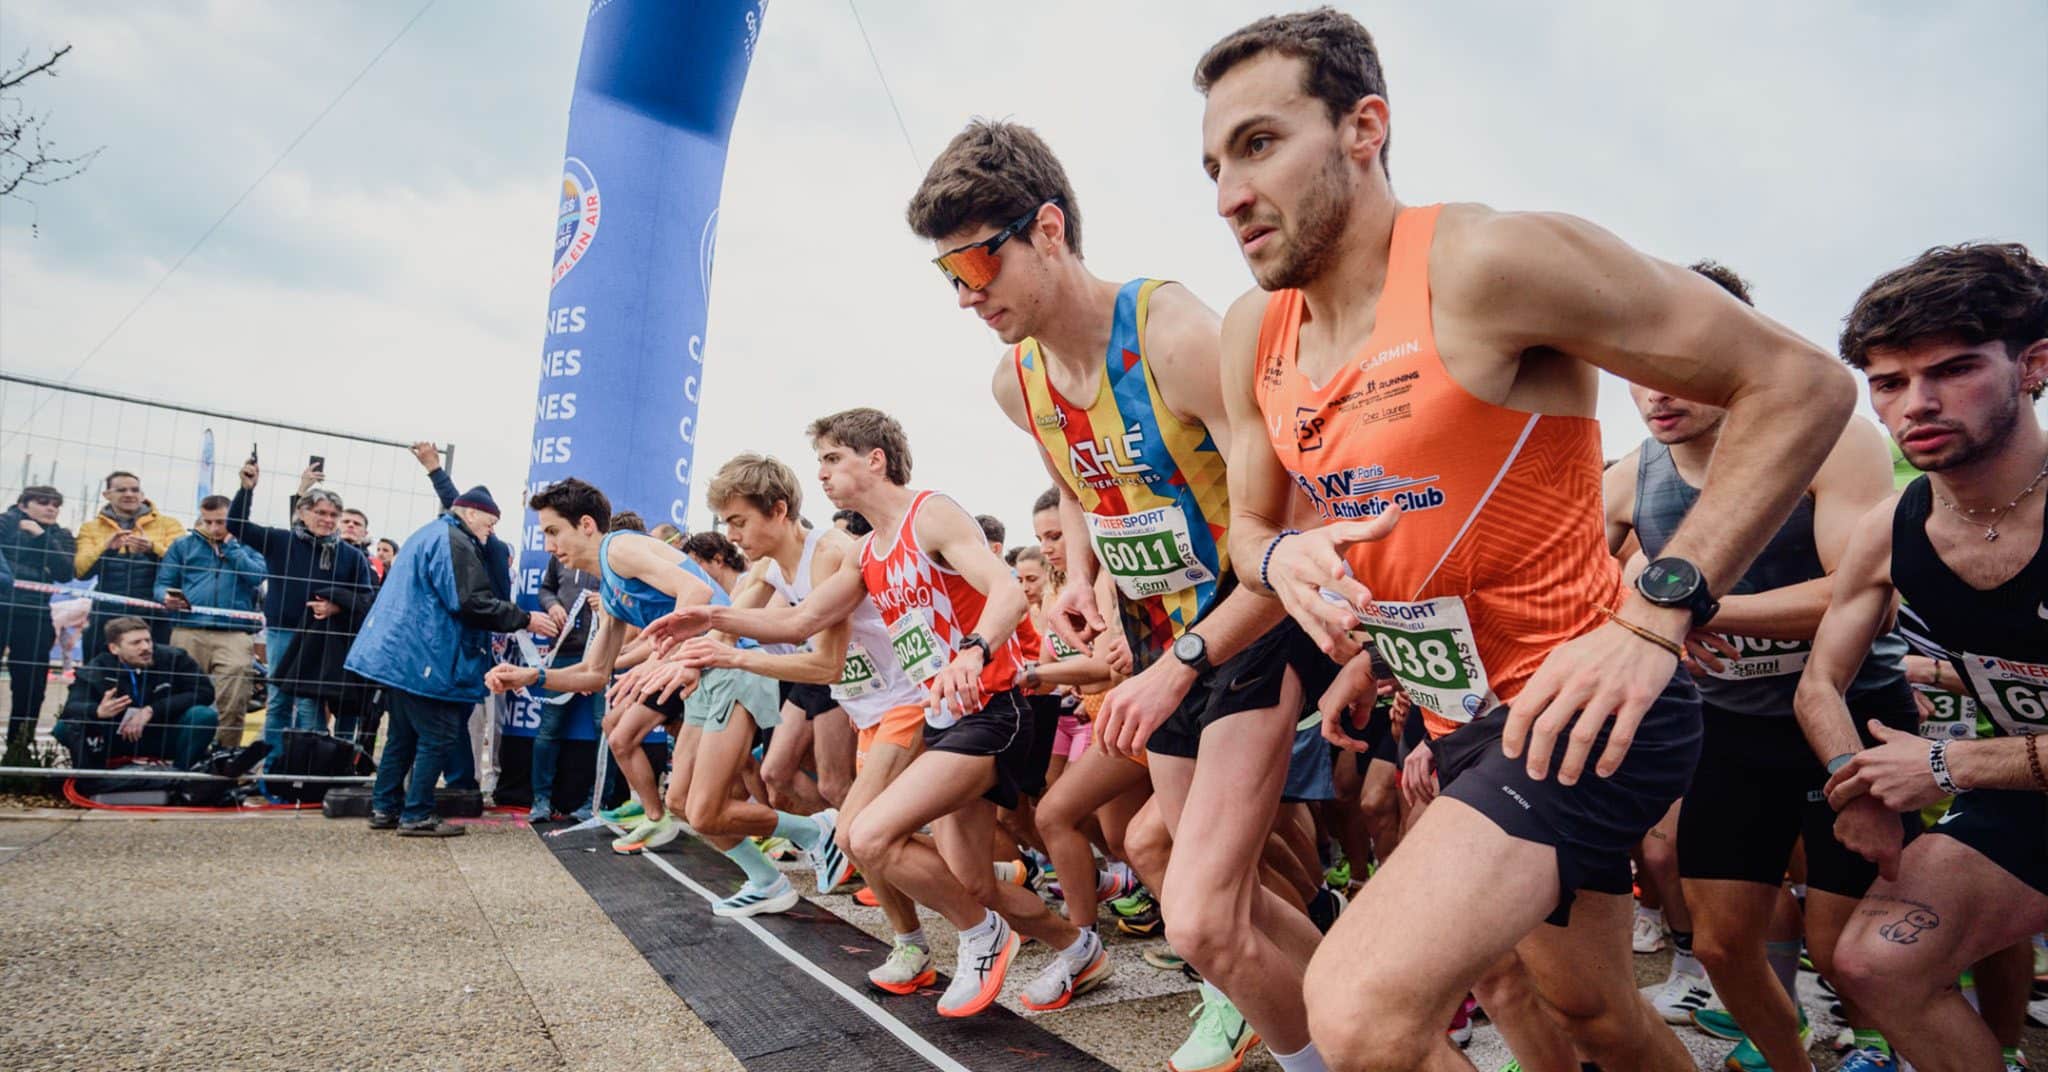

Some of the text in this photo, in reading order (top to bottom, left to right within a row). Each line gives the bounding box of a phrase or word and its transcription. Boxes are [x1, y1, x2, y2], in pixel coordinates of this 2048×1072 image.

[586, 194, 598, 226] AIR
[1360, 340, 1419, 372] GARMIN
[1382, 402, 1411, 417] Laurent
[1357, 464, 1384, 479] Paris
[1332, 487, 1444, 518] Athletic Club
[1103, 538, 1178, 572] 6011
[1178, 543, 1198, 567] SAS
[1456, 642, 1479, 680] SAS
